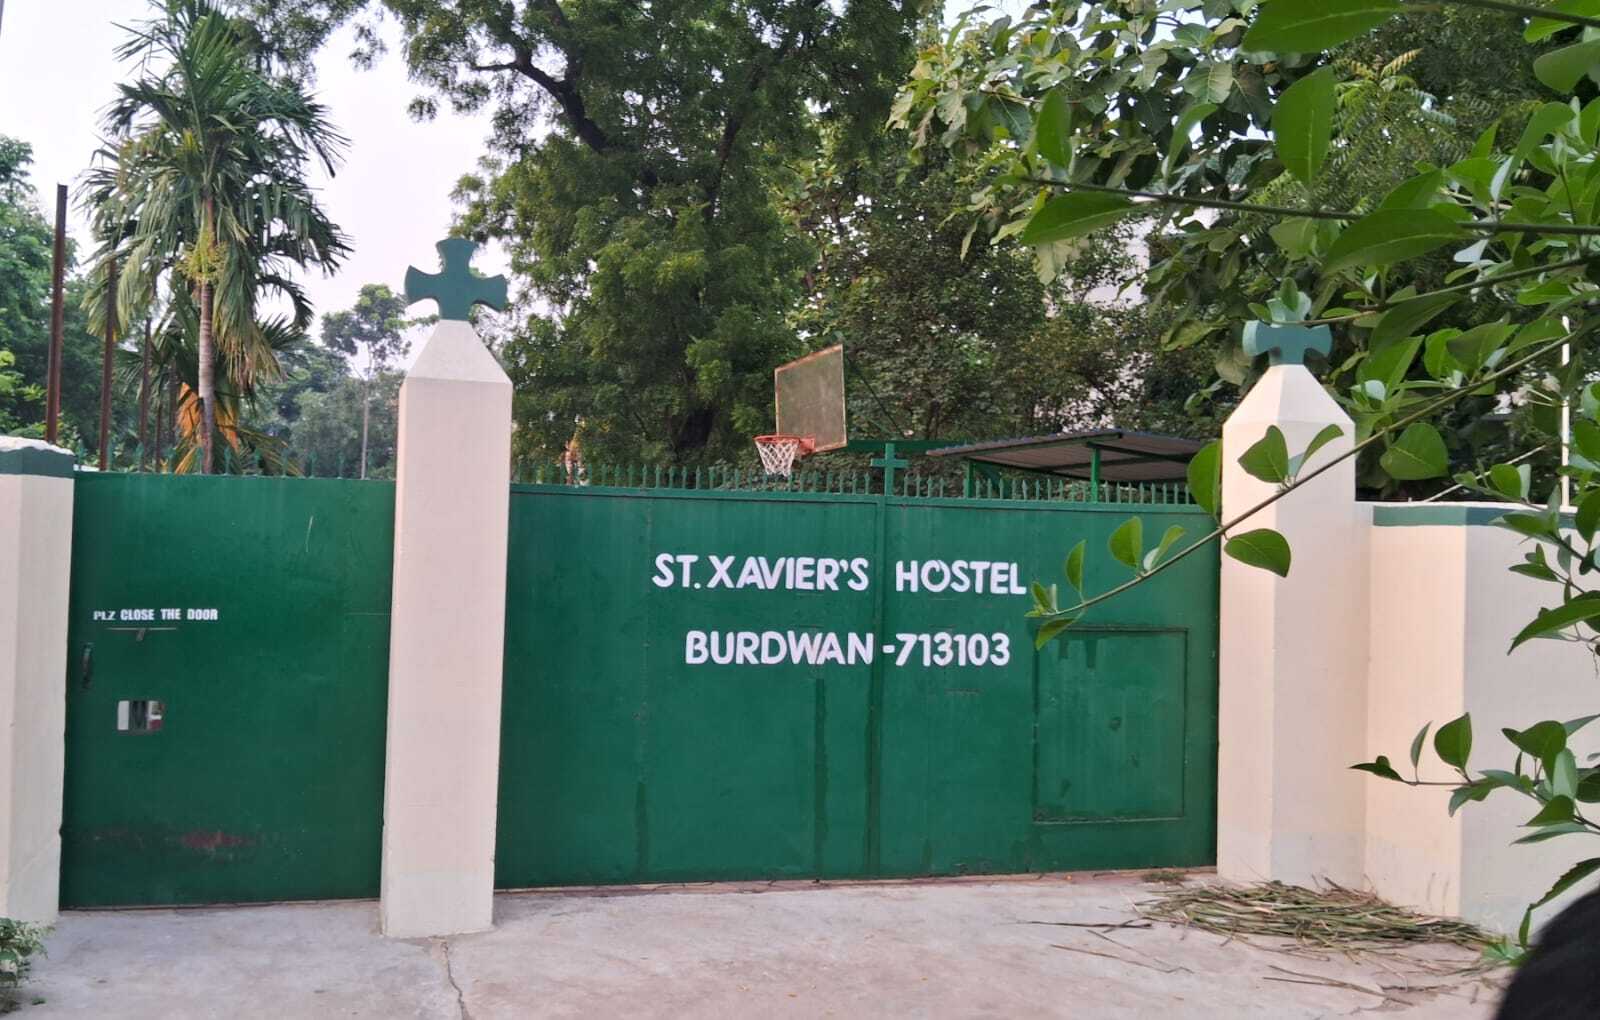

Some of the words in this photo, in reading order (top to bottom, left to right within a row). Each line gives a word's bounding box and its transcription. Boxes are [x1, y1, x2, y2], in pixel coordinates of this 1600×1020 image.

[895, 559, 1027, 595] HOSTEL
[93, 610, 116, 621] PLZ
[120, 608, 155, 621] CLOSE
[160, 608, 181, 620] THE
[186, 608, 219, 621] DOOR
[685, 630, 874, 665] BURDWAN
